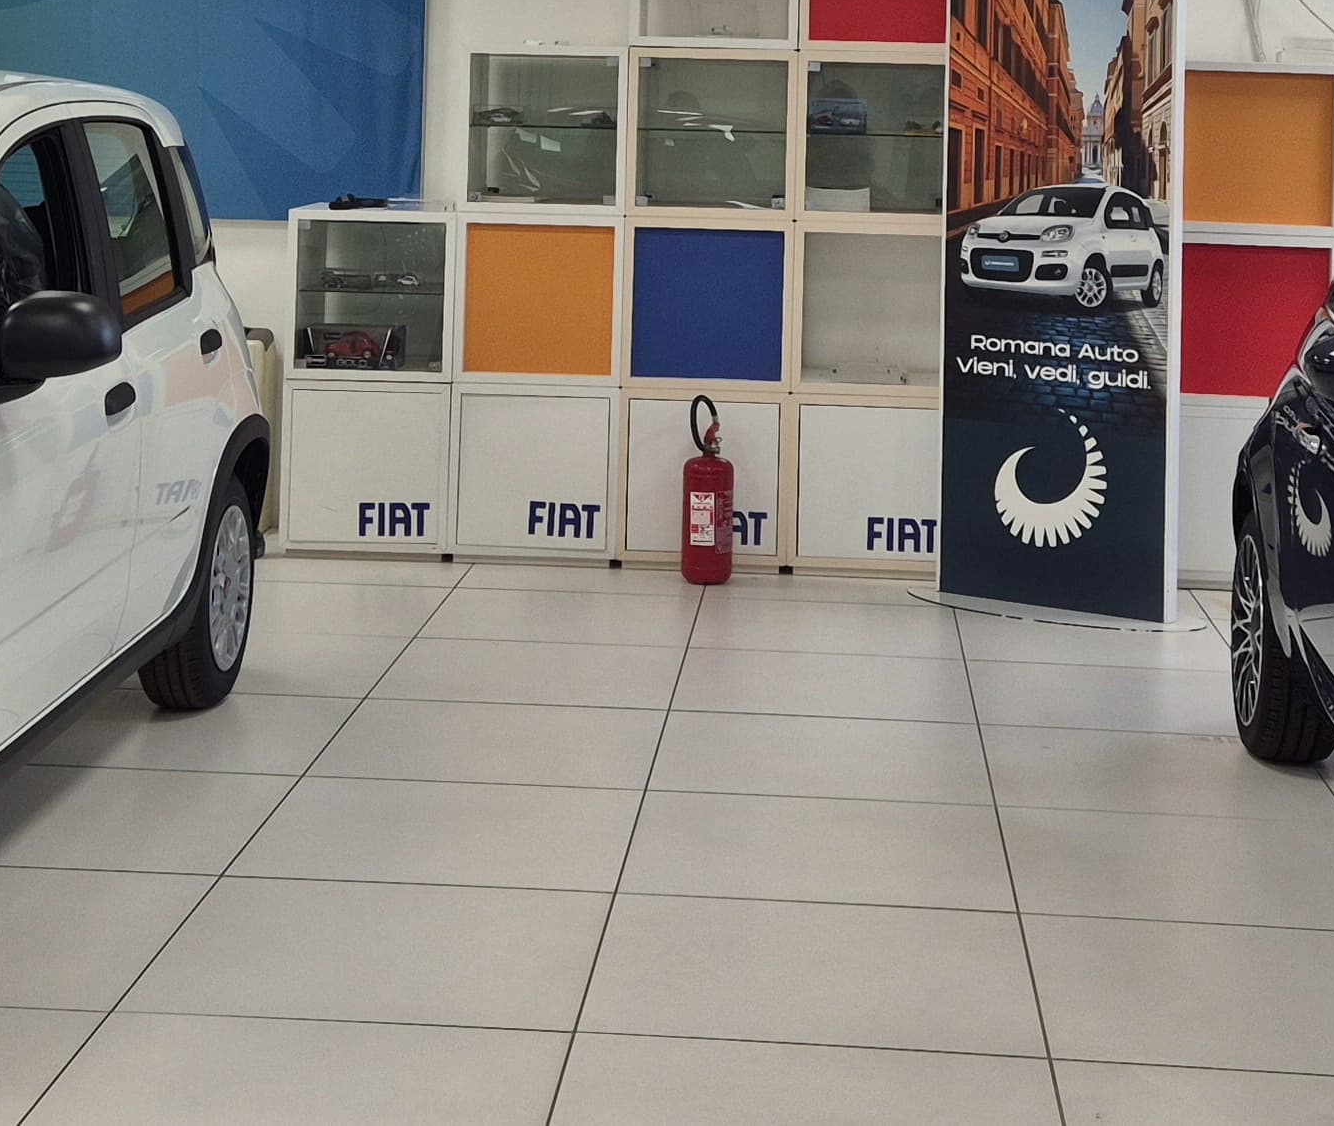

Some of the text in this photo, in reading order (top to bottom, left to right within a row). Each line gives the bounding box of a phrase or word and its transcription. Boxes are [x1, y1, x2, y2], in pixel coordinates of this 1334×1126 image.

[970, 334, 1139, 363] Romana Auto
[956, 356, 1152, 390] Vieni, vedi, guidi.
[358, 502, 430, 537] FIAT
[528, 501, 601, 538] FIAT
[733, 511, 768, 546] AT
[867, 516, 938, 553] FIAT
